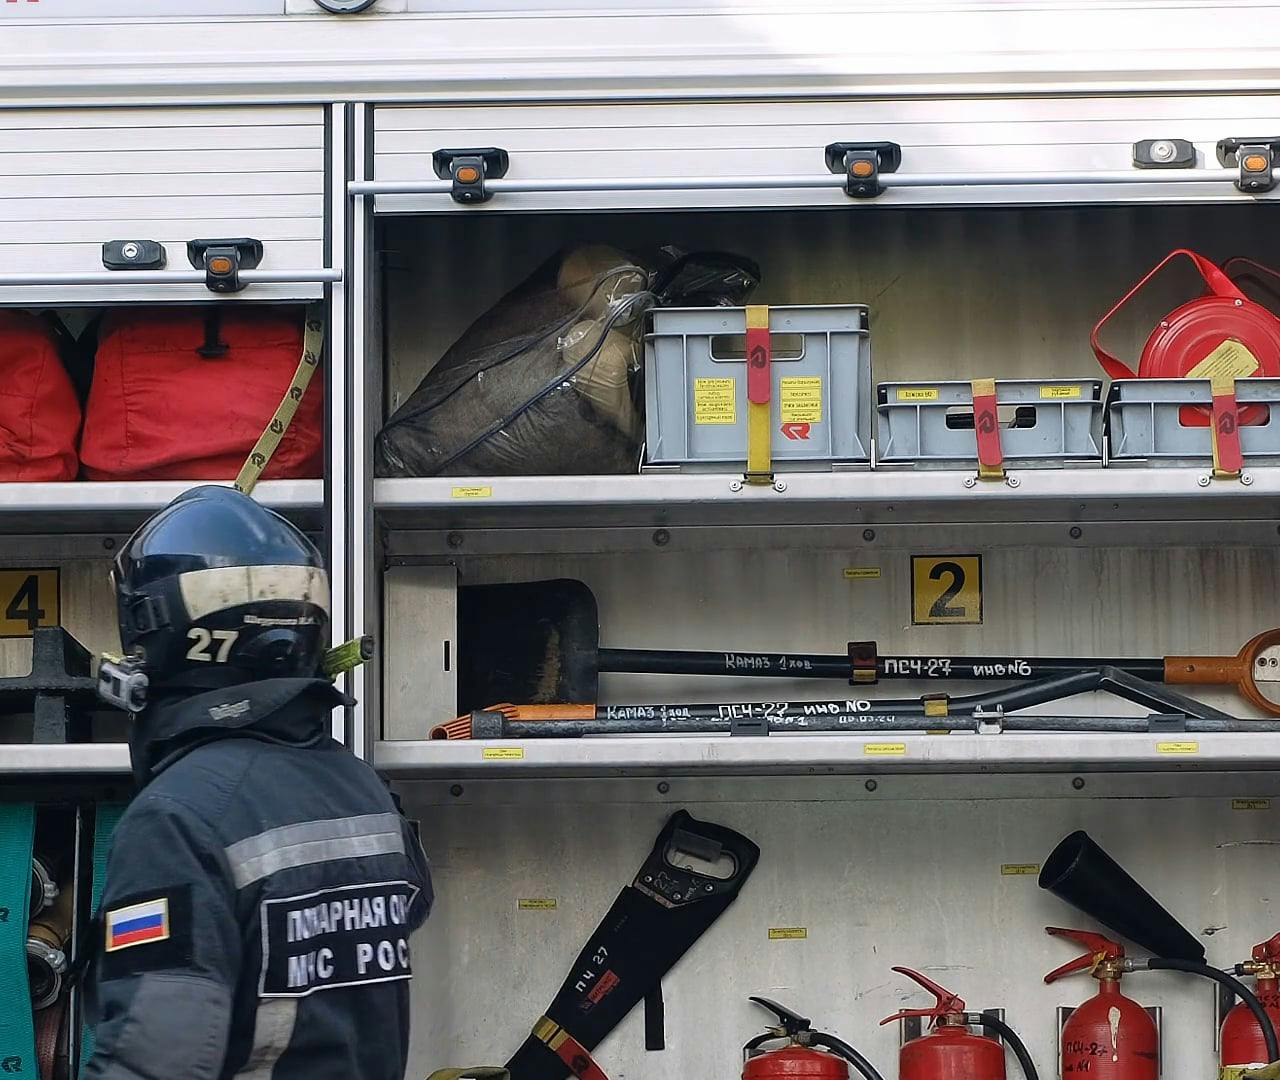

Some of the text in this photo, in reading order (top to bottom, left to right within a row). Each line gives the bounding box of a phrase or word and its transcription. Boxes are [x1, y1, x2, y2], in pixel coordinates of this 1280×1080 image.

[6, 575, 45, 631] 4
[929, 562, 966, 617] 2
[186, 627, 239, 663] 27
